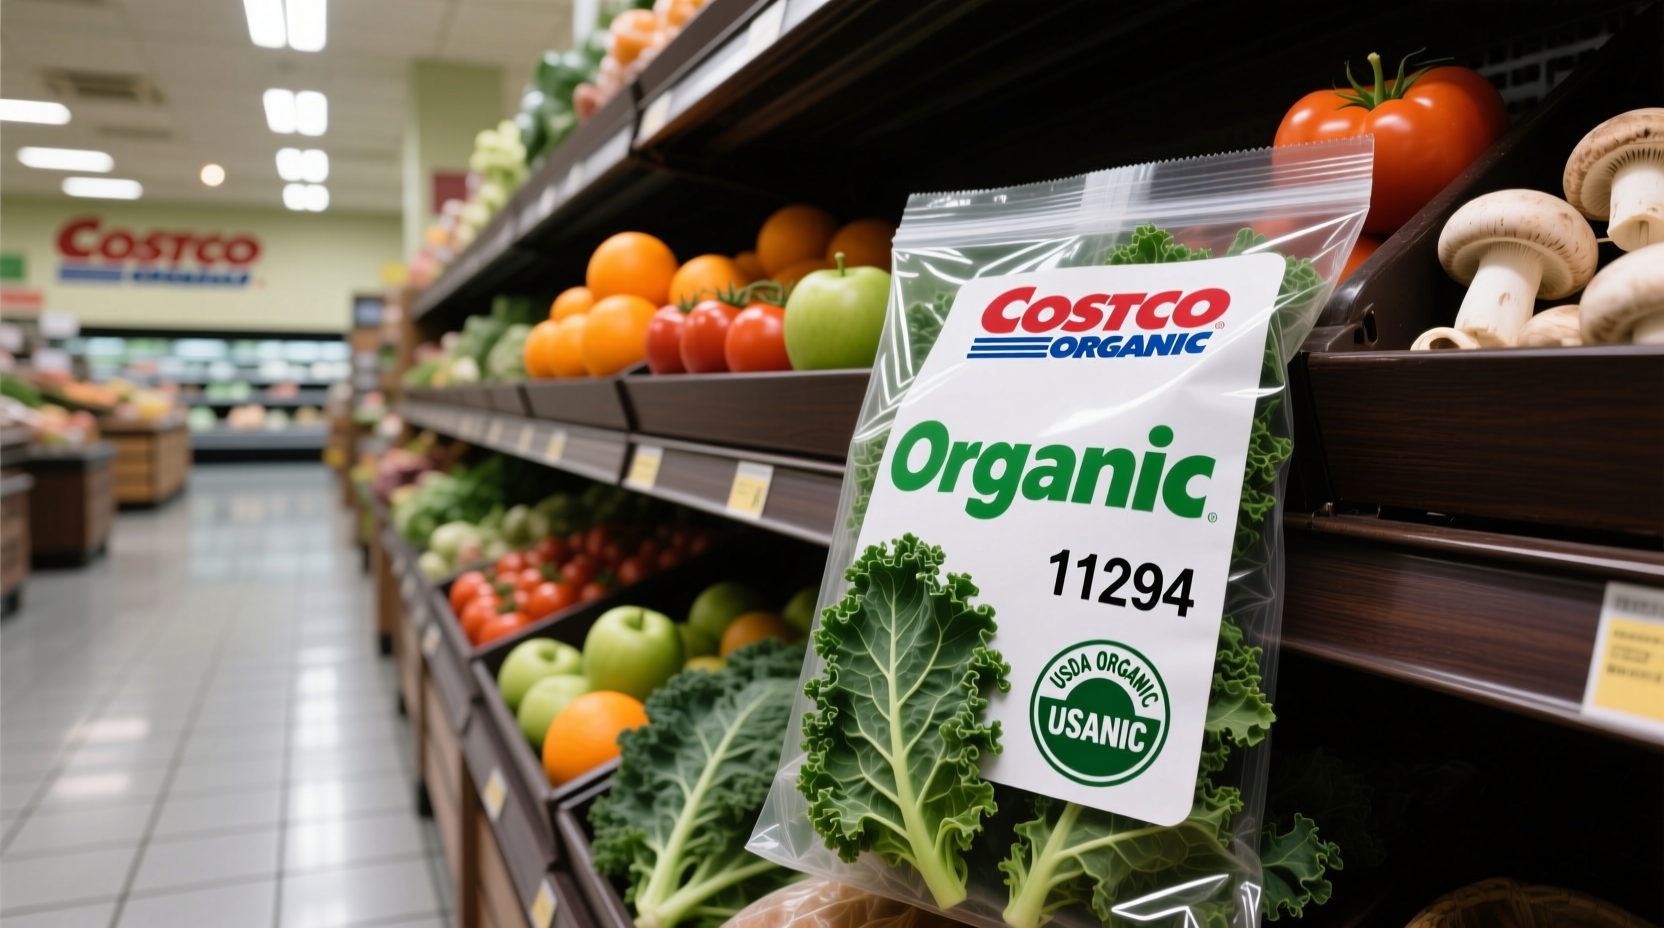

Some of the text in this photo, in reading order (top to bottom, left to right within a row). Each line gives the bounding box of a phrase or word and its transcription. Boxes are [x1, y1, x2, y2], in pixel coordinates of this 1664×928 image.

[57, 217, 260, 267] COSTCO
[980, 286, 1231, 334] COSTCO
[1049, 331, 1214, 359] ORGANIC
[890, 420, 1216, 520] Organic
[1049, 549, 1195, 618] 11294
[1049, 650, 1159, 708] USDA ORGANIC
[1048, 704, 1147, 753] USANIC
